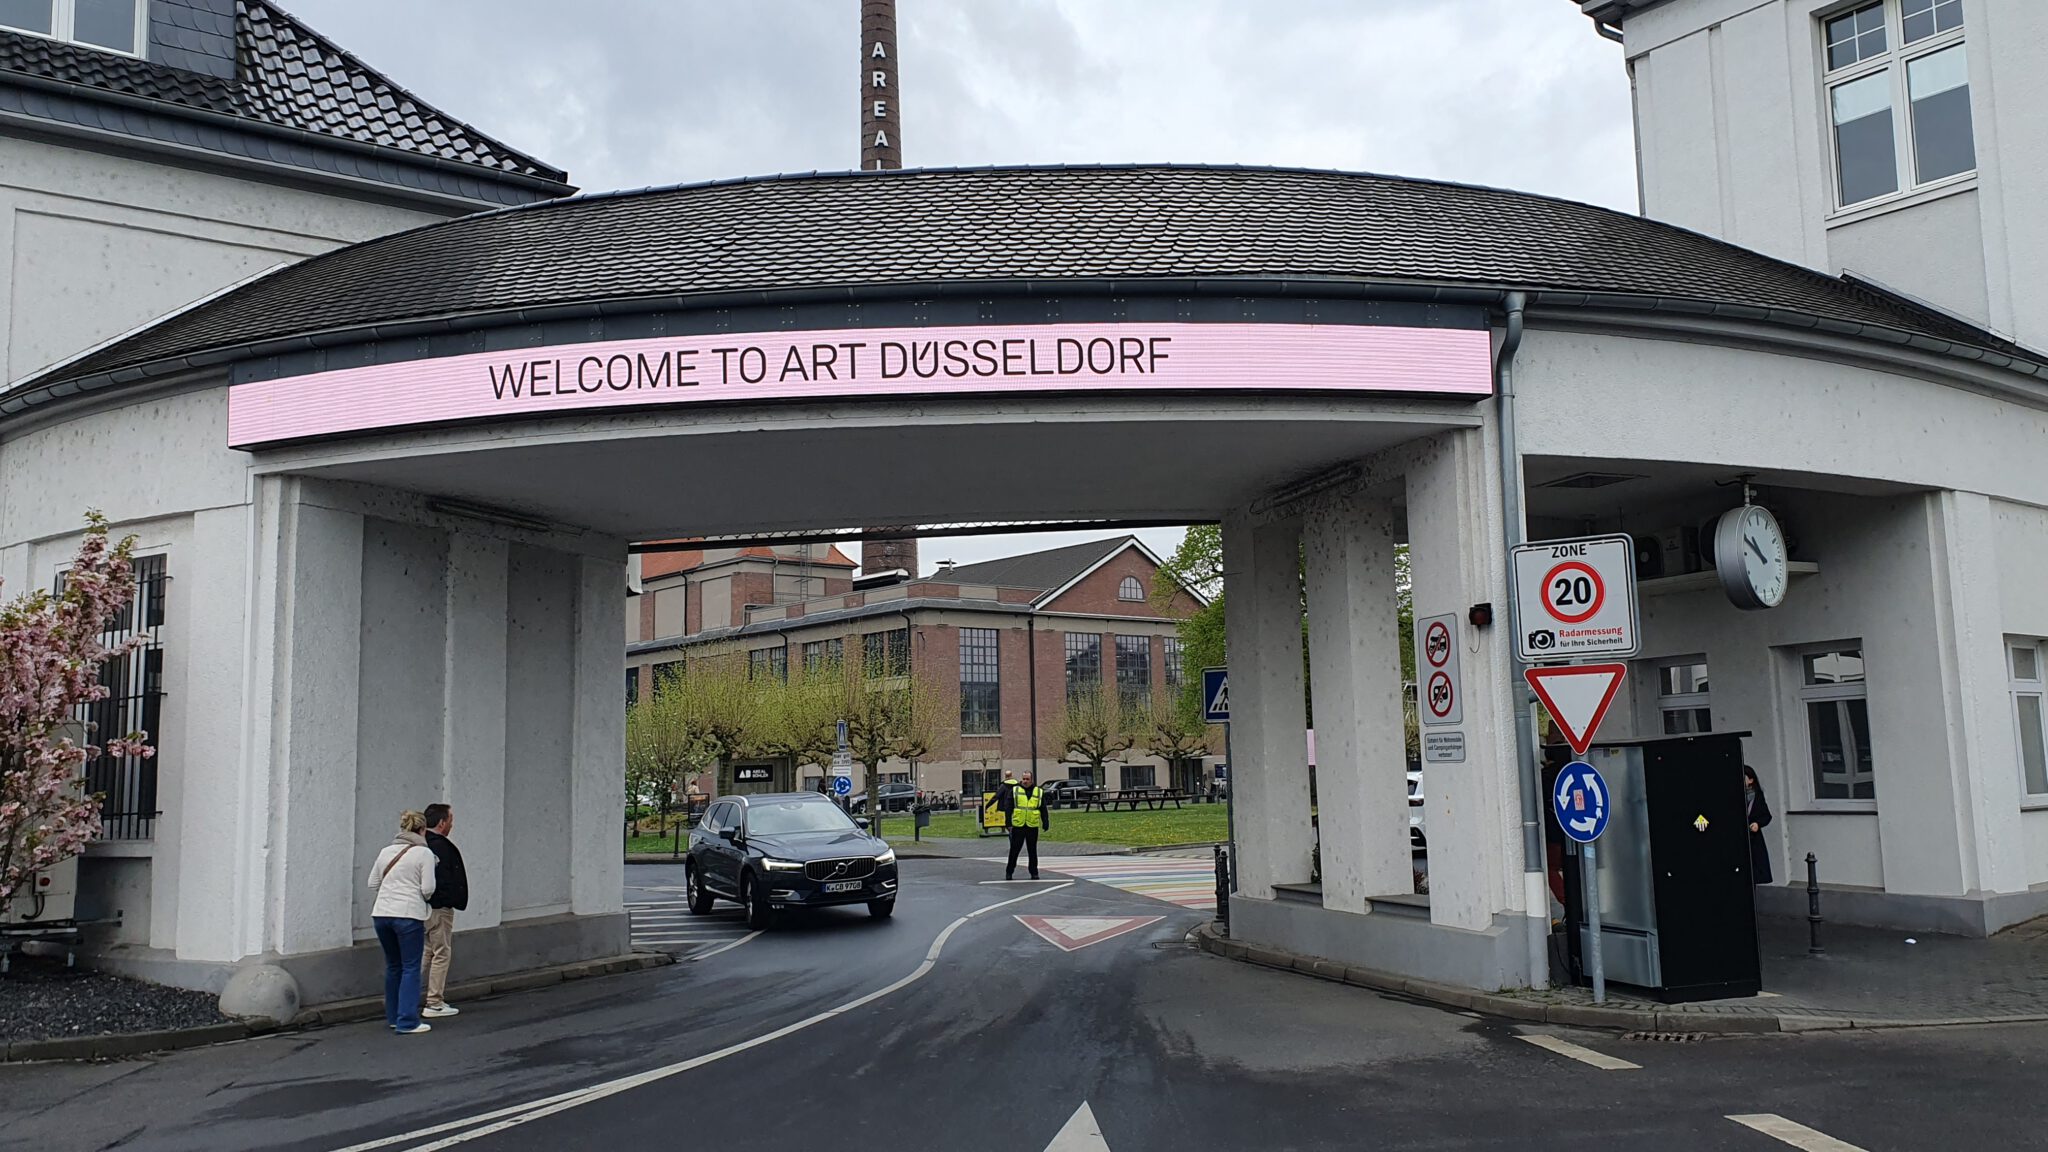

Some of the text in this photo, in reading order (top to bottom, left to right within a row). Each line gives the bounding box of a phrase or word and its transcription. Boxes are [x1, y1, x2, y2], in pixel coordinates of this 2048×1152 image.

[489, 350, 700, 400] WELCOME
[711, 346, 767, 385] TO
[779, 342, 867, 382] ART
[1551, 543, 1588, 559] ZONE
[1554, 576, 1592, 606] 20
[1559, 626, 1623, 638] Radarmessung
[1560, 637, 1624, 648] für Ihre Sicherheit
